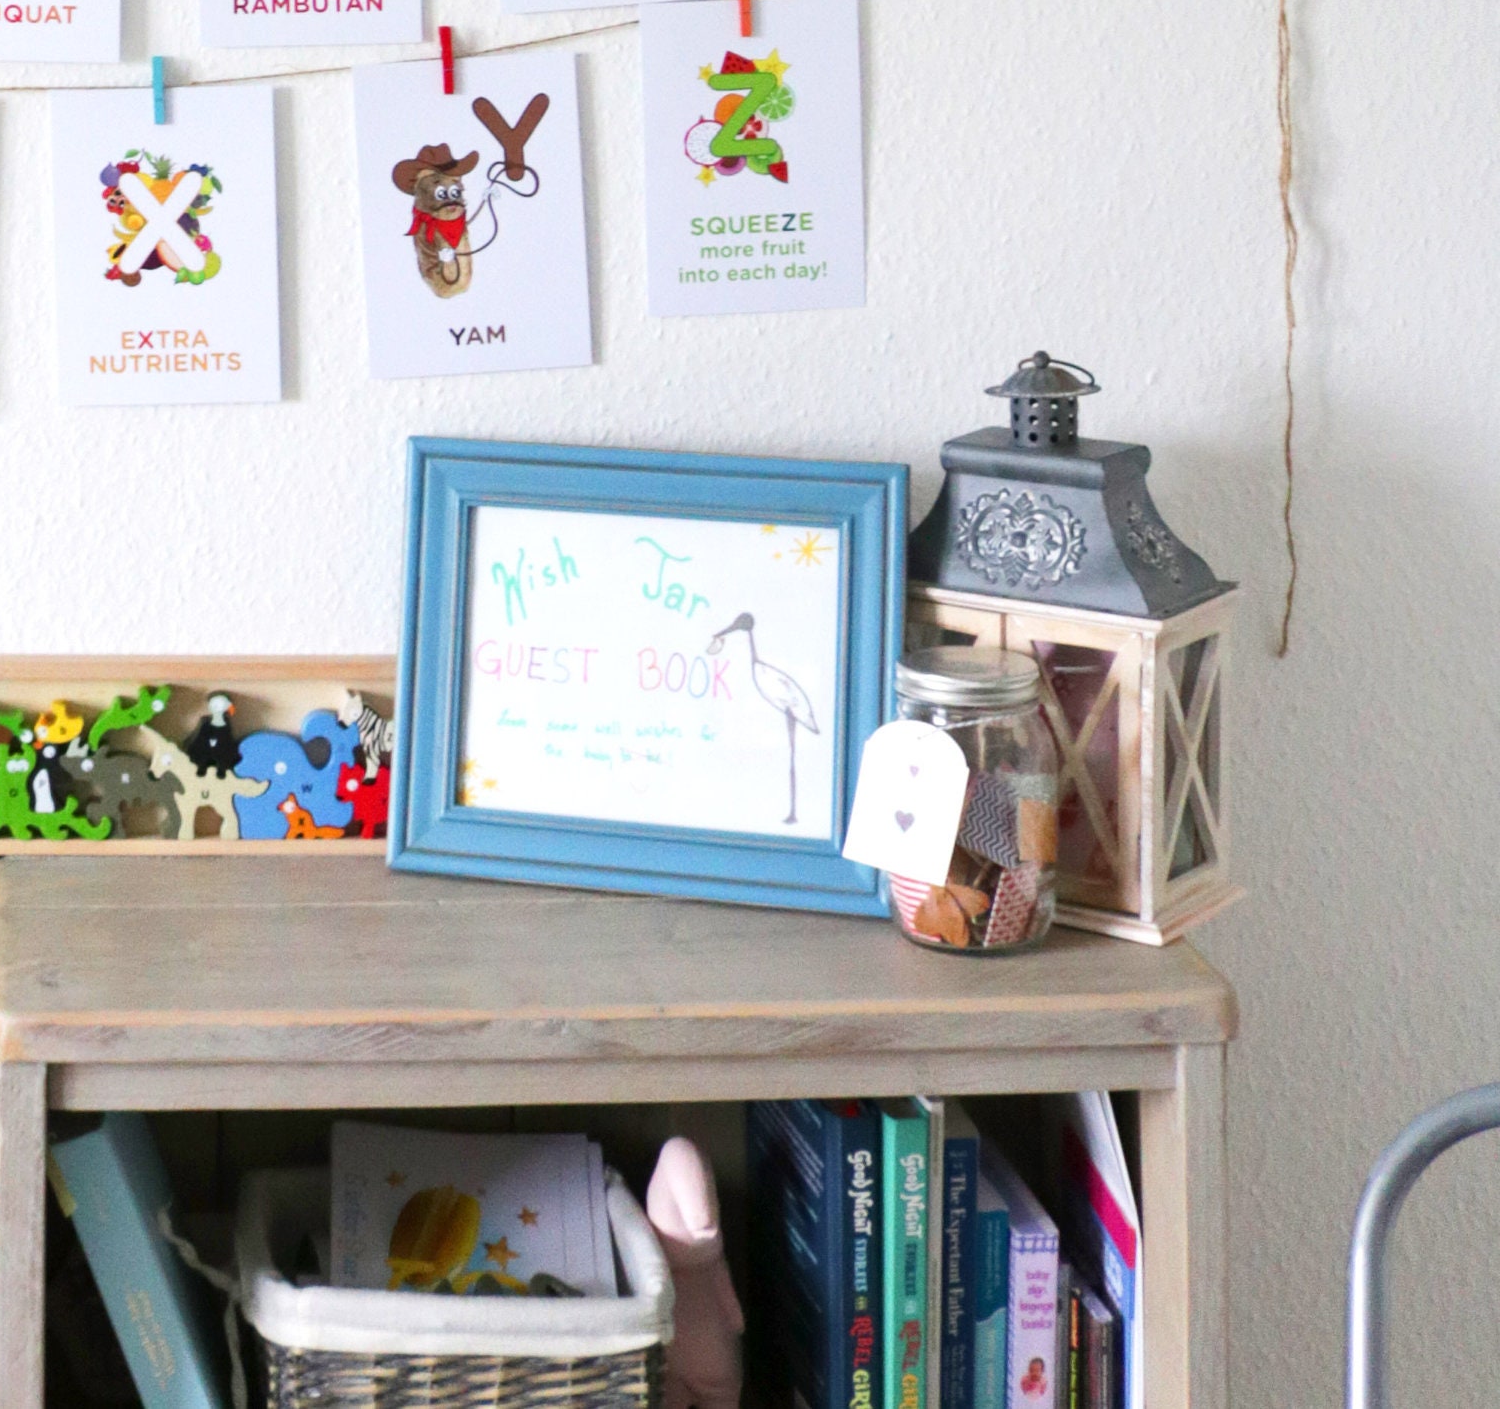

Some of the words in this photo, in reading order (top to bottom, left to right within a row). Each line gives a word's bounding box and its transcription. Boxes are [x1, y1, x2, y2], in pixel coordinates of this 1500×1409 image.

[472, 92, 550, 182] Y
[708, 71, 779, 158] Z
[118, 171, 206, 275] X
[690, 212, 814, 236] SQUEEZE
[678, 267, 720, 283] into
[727, 264, 776, 281] each
[783, 261, 828, 281] day!
[700, 244, 754, 259] more
[761, 239, 806, 256] fruit
[120, 329, 210, 351] EXTRA
[449, 323, 507, 347] YAM
[89, 351, 242, 375] NUTRIENTS
[491, 536, 580, 625] Wish
[635, 536, 710, 619] Jar
[473, 639, 598, 683] GUEST
[637, 647, 733, 700] BOOK
[949, 1174, 967, 1204] The
[946, 1208, 967, 1283] Expectant
[947, 1287, 966, 1337] Father
[849, 1316, 874, 1367] REBEL
